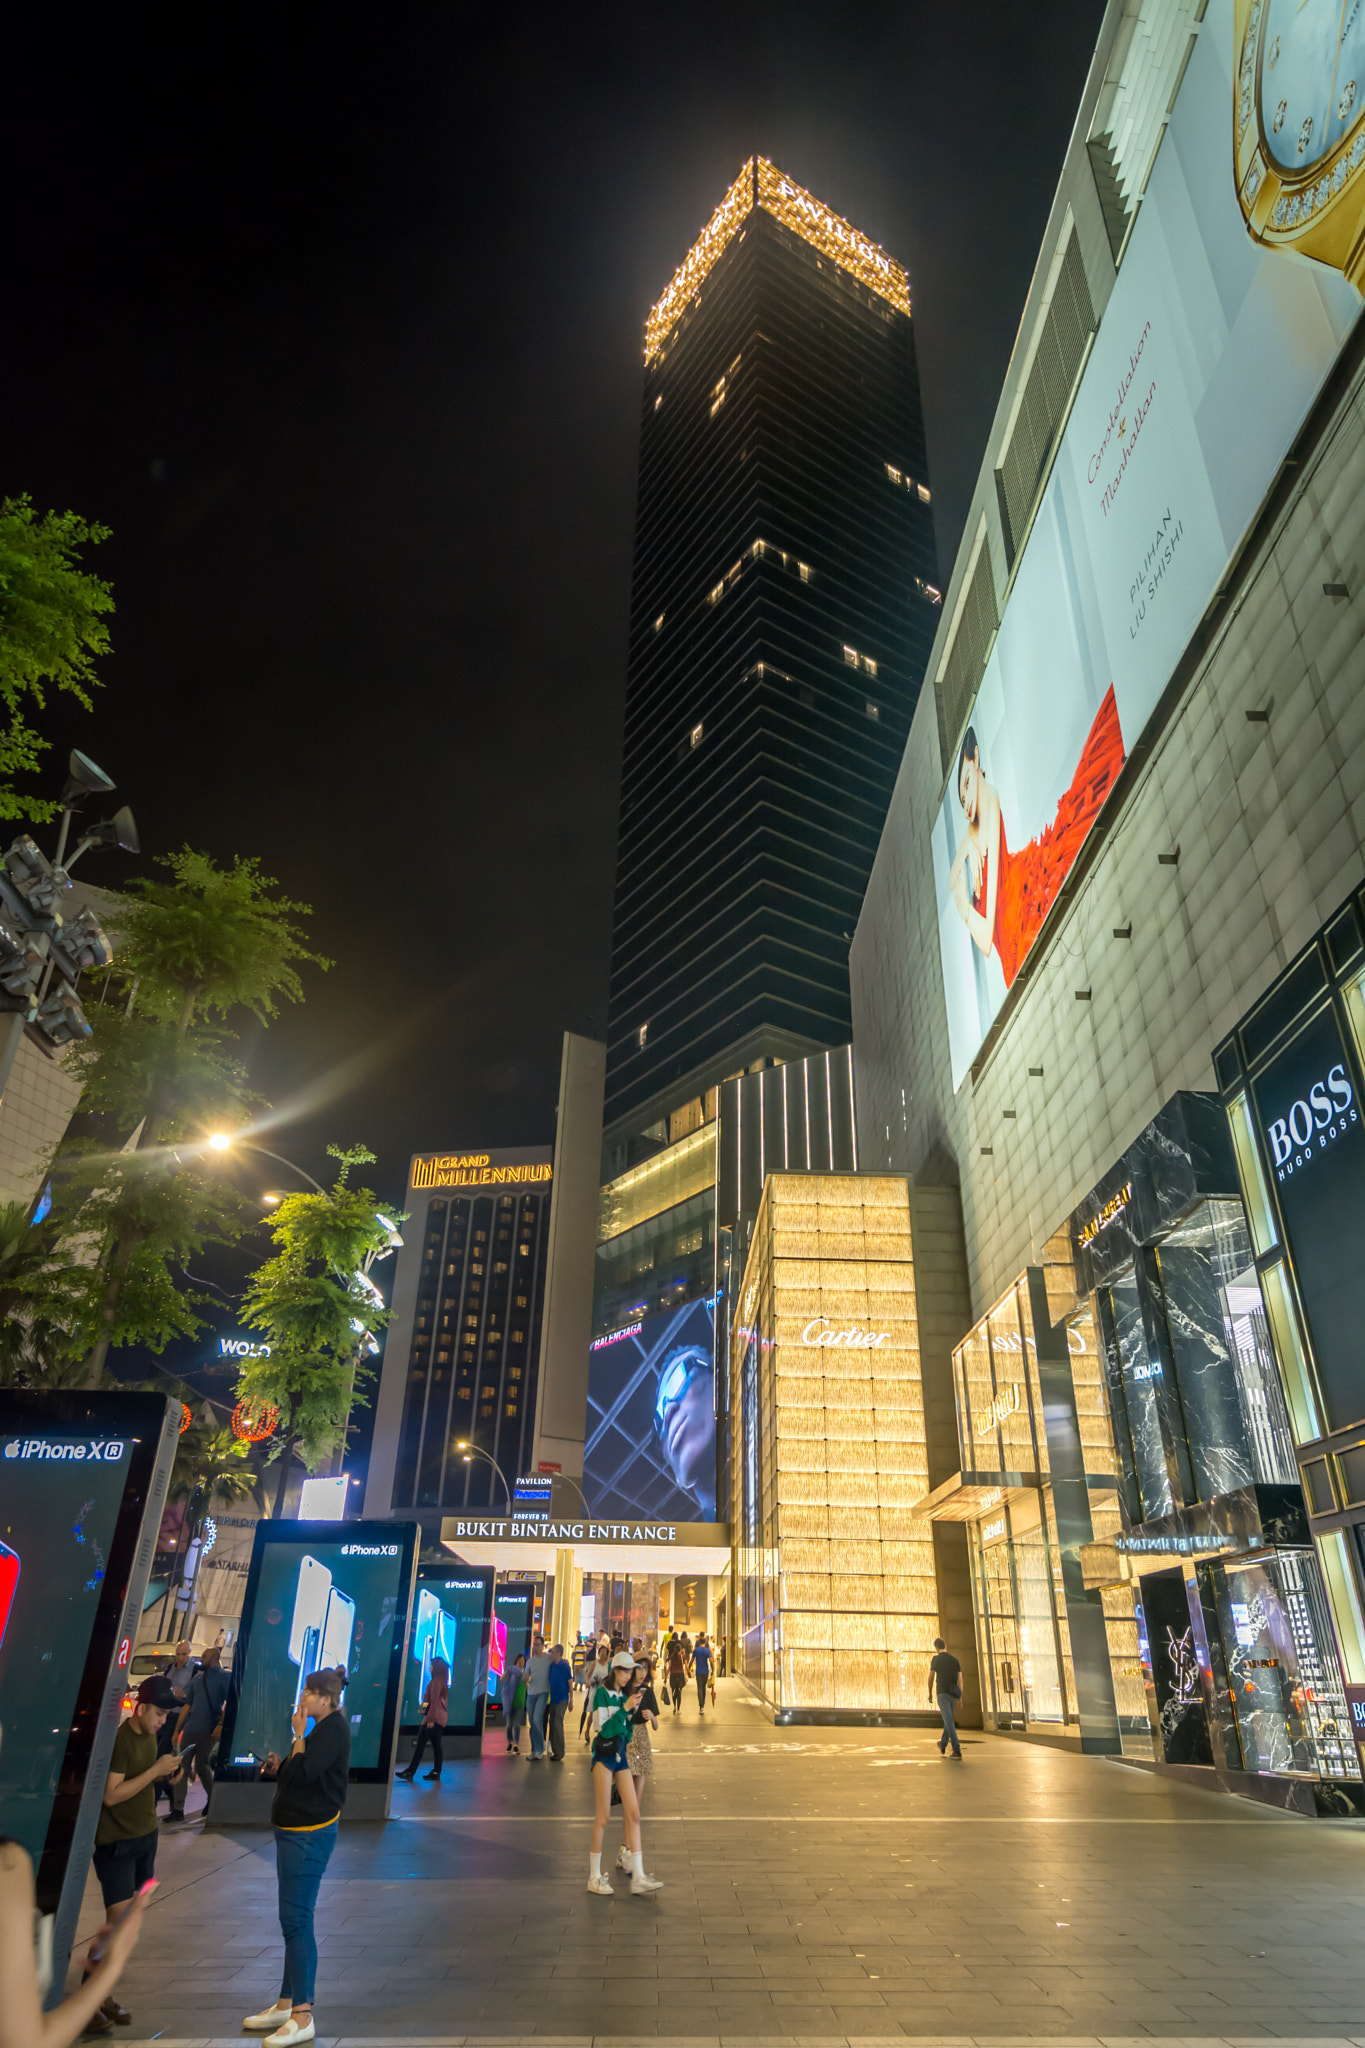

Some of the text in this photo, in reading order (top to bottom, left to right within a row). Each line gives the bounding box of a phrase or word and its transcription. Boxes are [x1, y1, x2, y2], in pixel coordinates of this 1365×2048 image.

[657, 191, 735, 321] PAVILION
[780, 181, 889, 274] PAVILION
[1087, 321, 1151, 484] Constellation
[1100, 381, 1156, 517] Manhattan
[1129, 507, 1172, 604] PILIHAN
[1129, 519, 1184, 640] LIU SHISHI
[1268, 1064, 1352, 1168] BOSS
[1278, 1109, 1358, 1182] HUGO BOSS
[438, 1155, 489, 1169] GRAND
[594, 1322, 642, 1351] BALENCIAGA
[803, 1319, 890, 1346] Cartier
[21, 1440, 86, 1460] iPhone
[516, 1477, 552, 1485] PAVILION
[349, 1545, 380, 1556] iPhone
[456, 1522, 676, 1541] BUKIT BINTANG ENTRANCE
